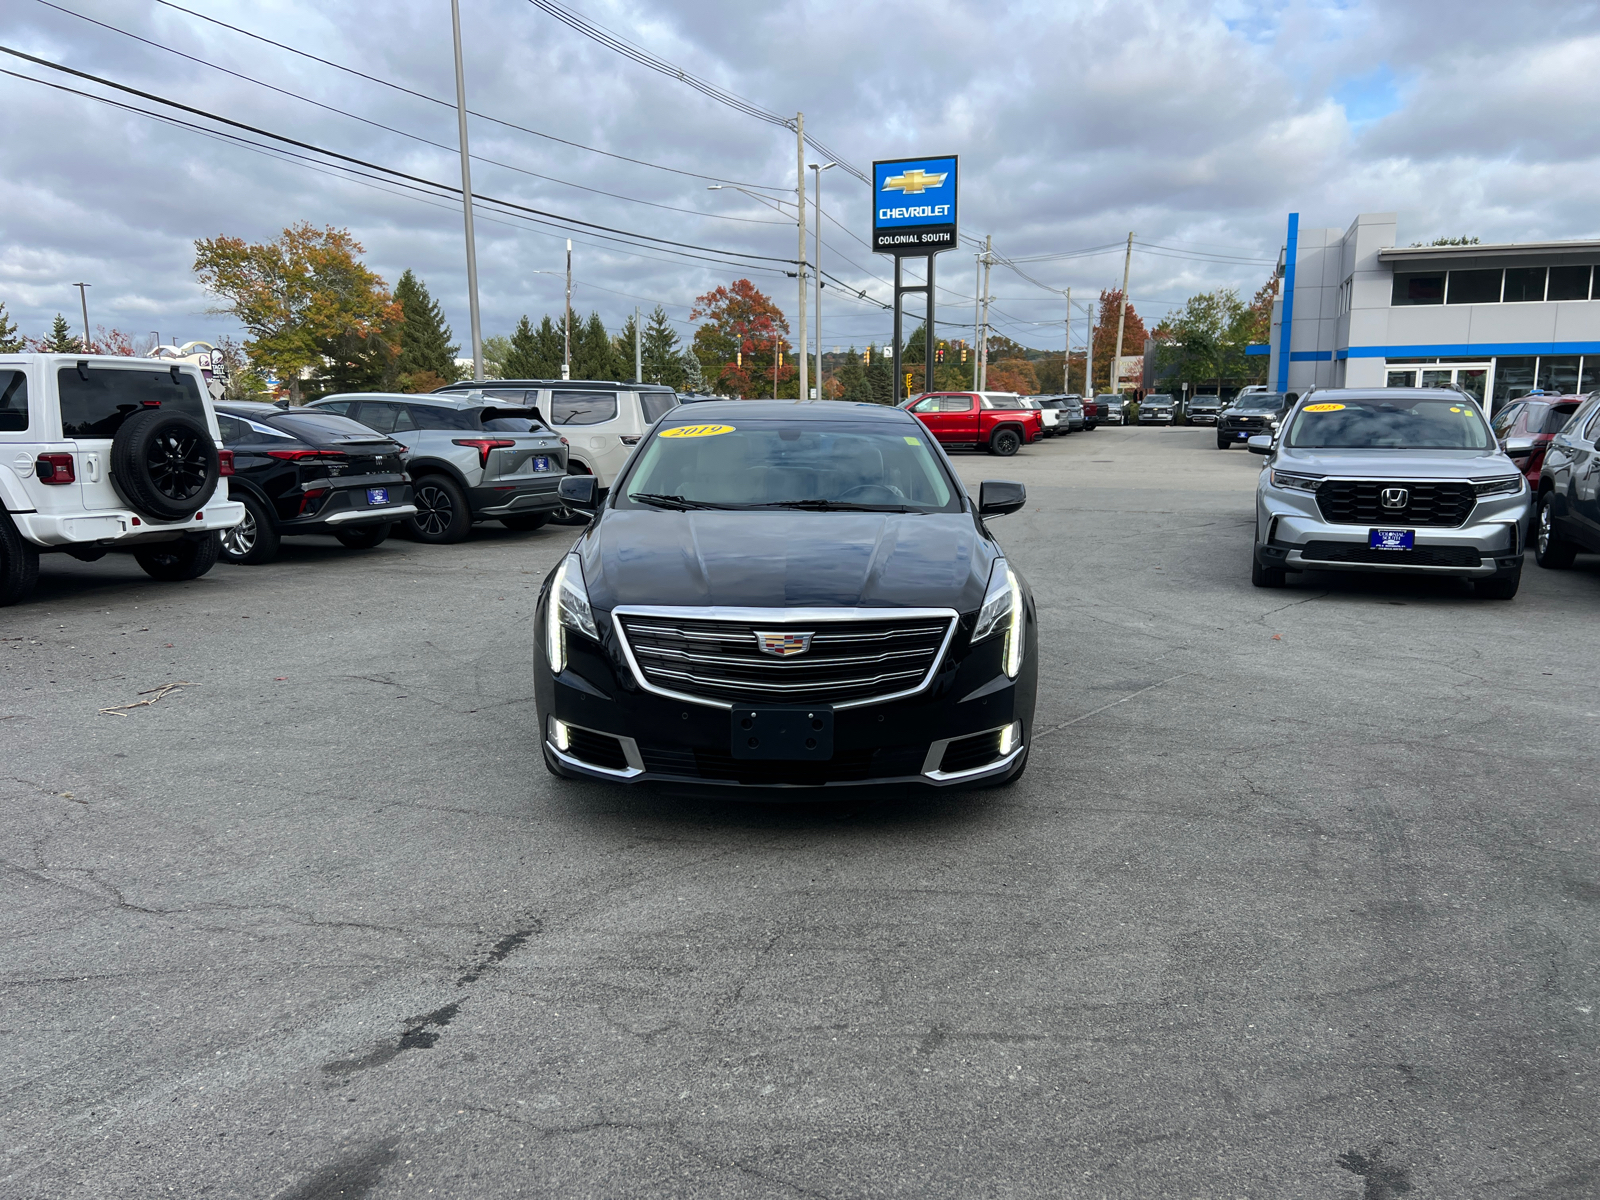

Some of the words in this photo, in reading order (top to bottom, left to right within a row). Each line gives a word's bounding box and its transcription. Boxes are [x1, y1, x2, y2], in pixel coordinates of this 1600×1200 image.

[879, 204, 950, 219] CHEVROLET
[878, 235, 919, 245] COLONIAL
[921, 233, 950, 242] SOUTH
[670, 426, 723, 436] 2019
